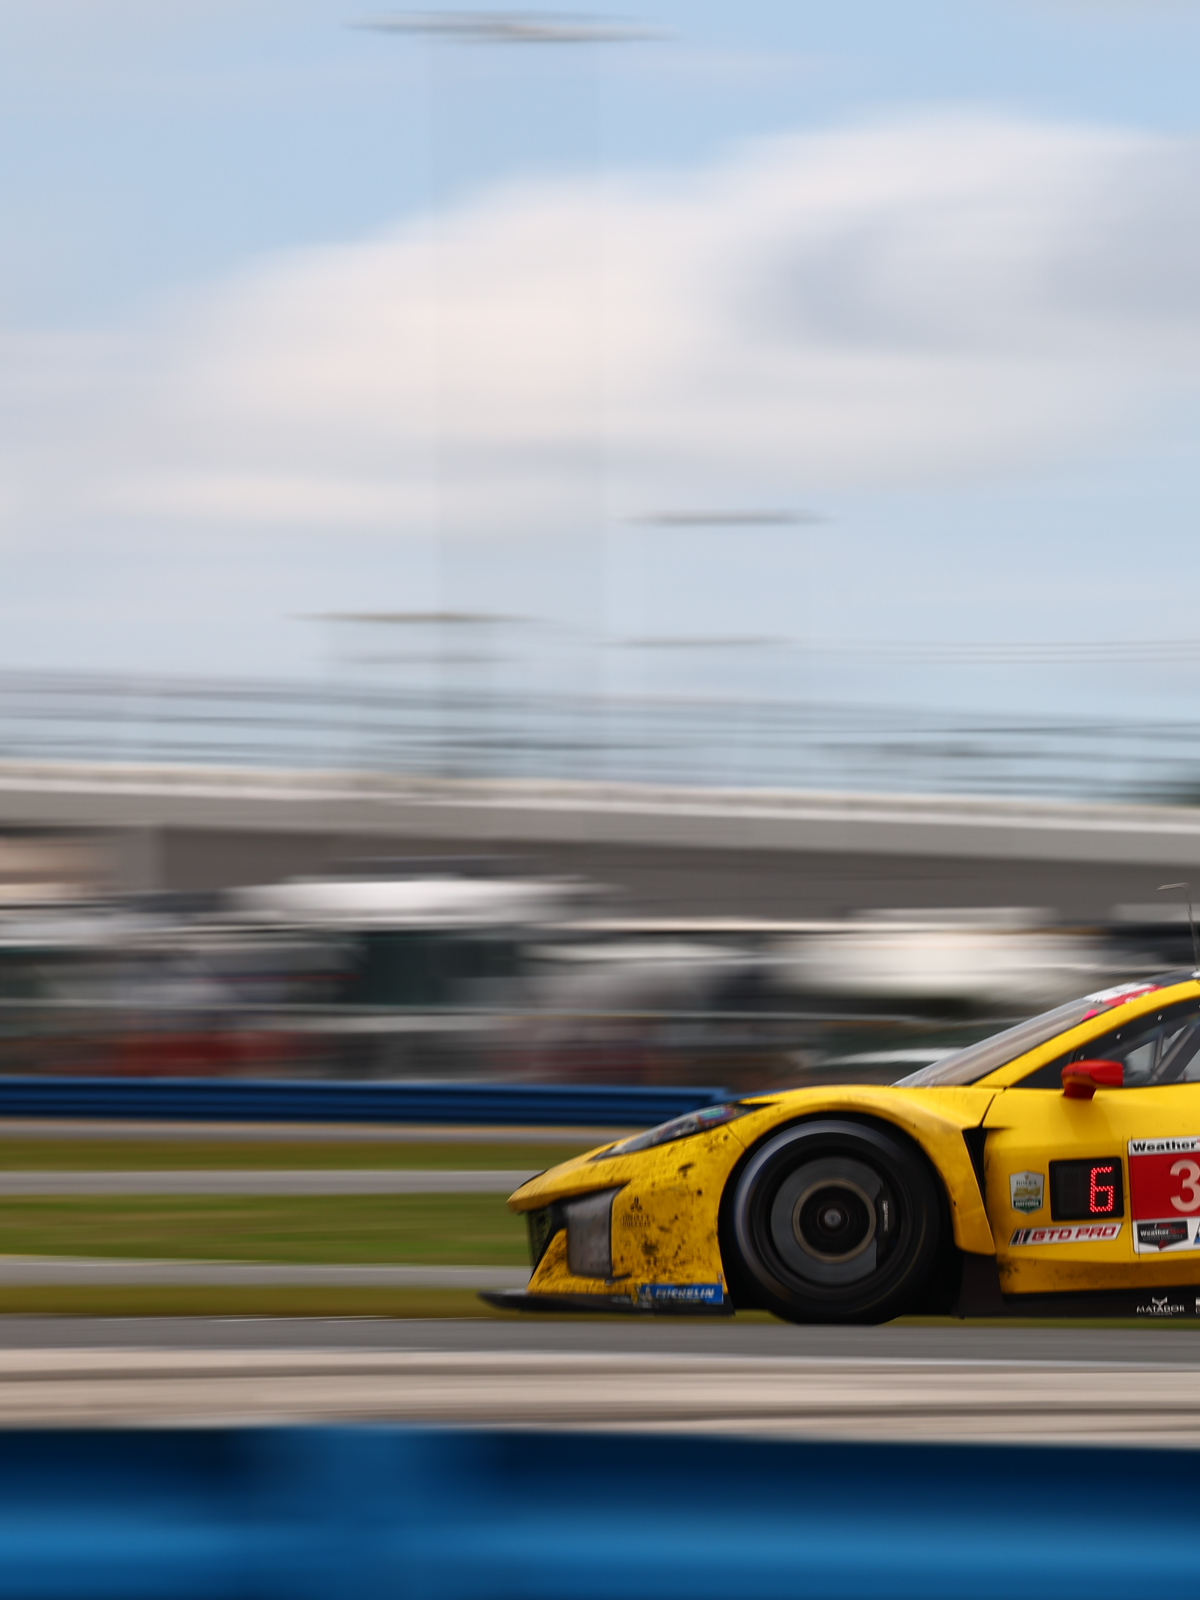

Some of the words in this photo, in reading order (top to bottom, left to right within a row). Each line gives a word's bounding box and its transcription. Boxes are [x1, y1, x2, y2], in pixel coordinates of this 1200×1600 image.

[1090, 1166, 1114, 1213] 6
[1031, 1228, 1073, 1241] GTD
[1075, 1226, 1117, 1240] PRO
[656, 1287, 715, 1299] MICHELIN
